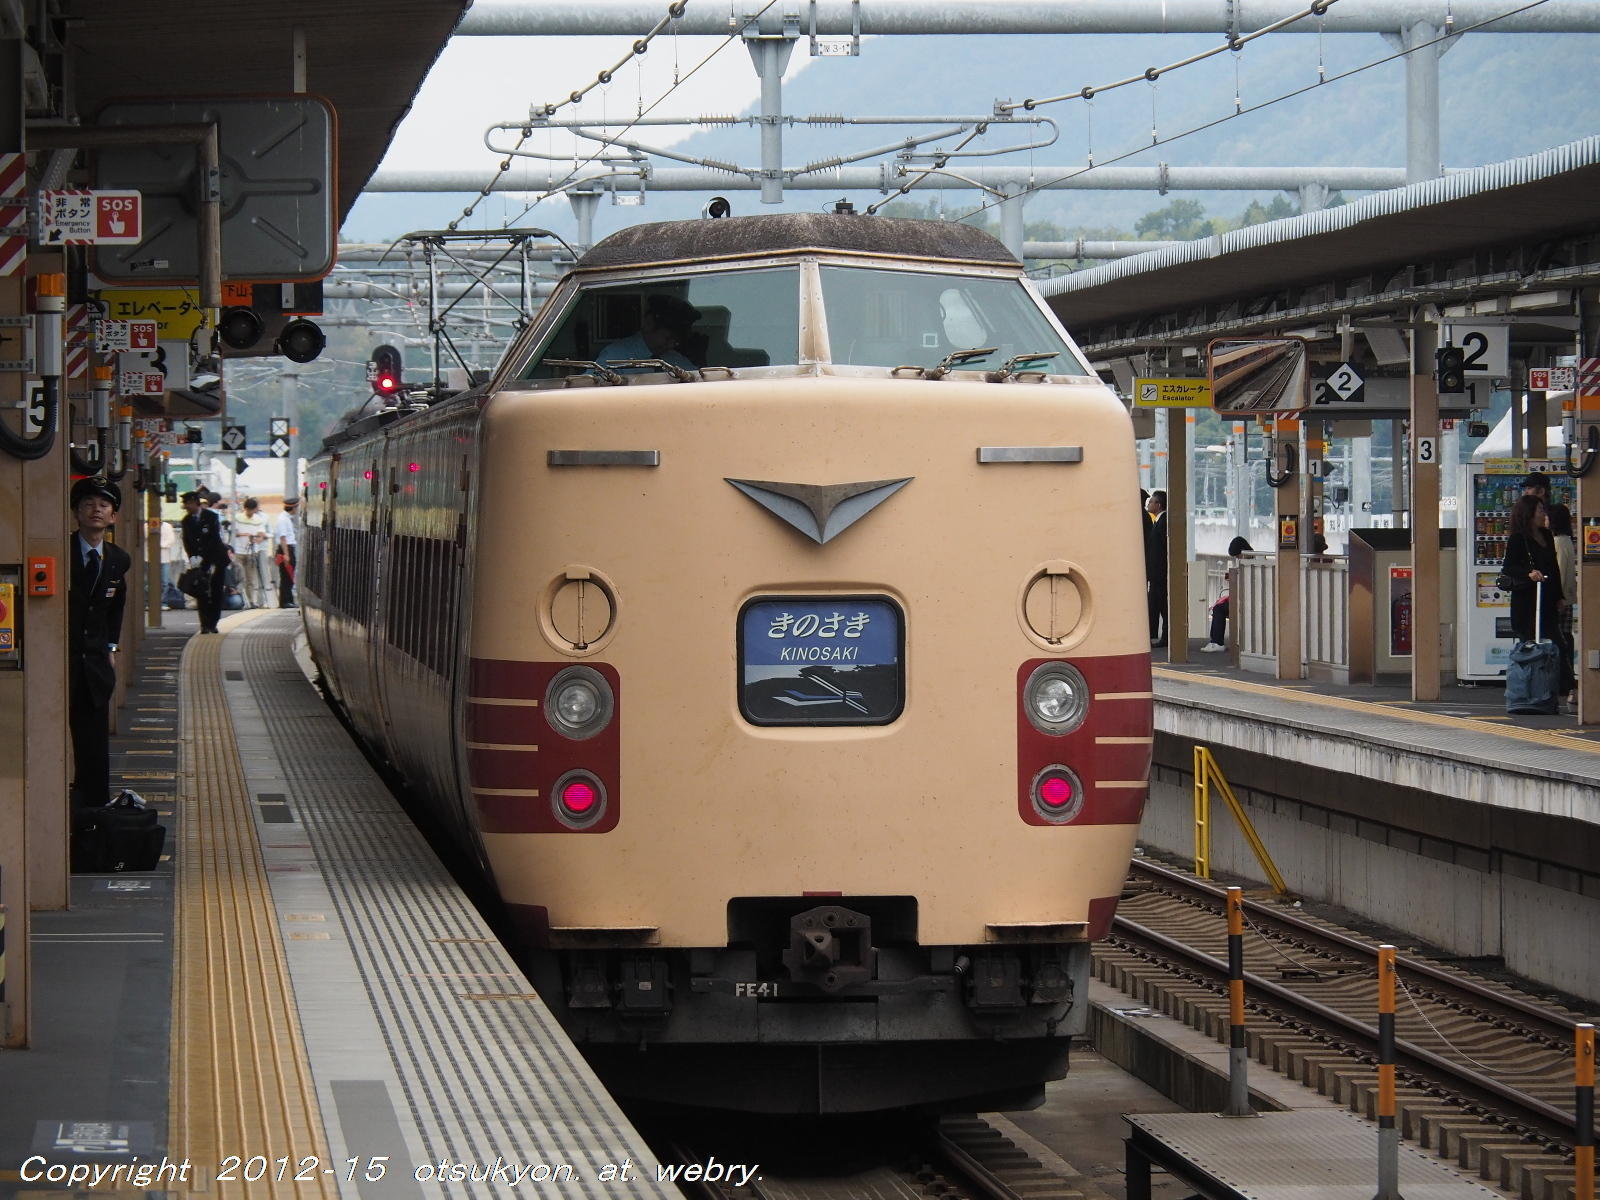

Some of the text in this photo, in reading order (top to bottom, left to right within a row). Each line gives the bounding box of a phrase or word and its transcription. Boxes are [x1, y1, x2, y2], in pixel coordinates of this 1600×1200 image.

[102, 199, 133, 211] SOS
[55, 209, 90, 219] ボタン
[133, 325, 153, 333] SOS
[1462, 331, 1489, 371] 2
[1338, 371, 1352, 391] 2
[1162, 385, 1211, 393] エスカレーター
[1315, 382, 1330, 404] 2
[1465, 382, 1476, 404] 1
[229, 432, 237, 444] 7
[1420, 440, 1433, 461] 3
[1311, 461, 1317, 475] 1
[767, 612, 870, 639] きのさき
[780, 646, 858, 661] KINOSAKI
[735, 982, 778, 997] FE41
